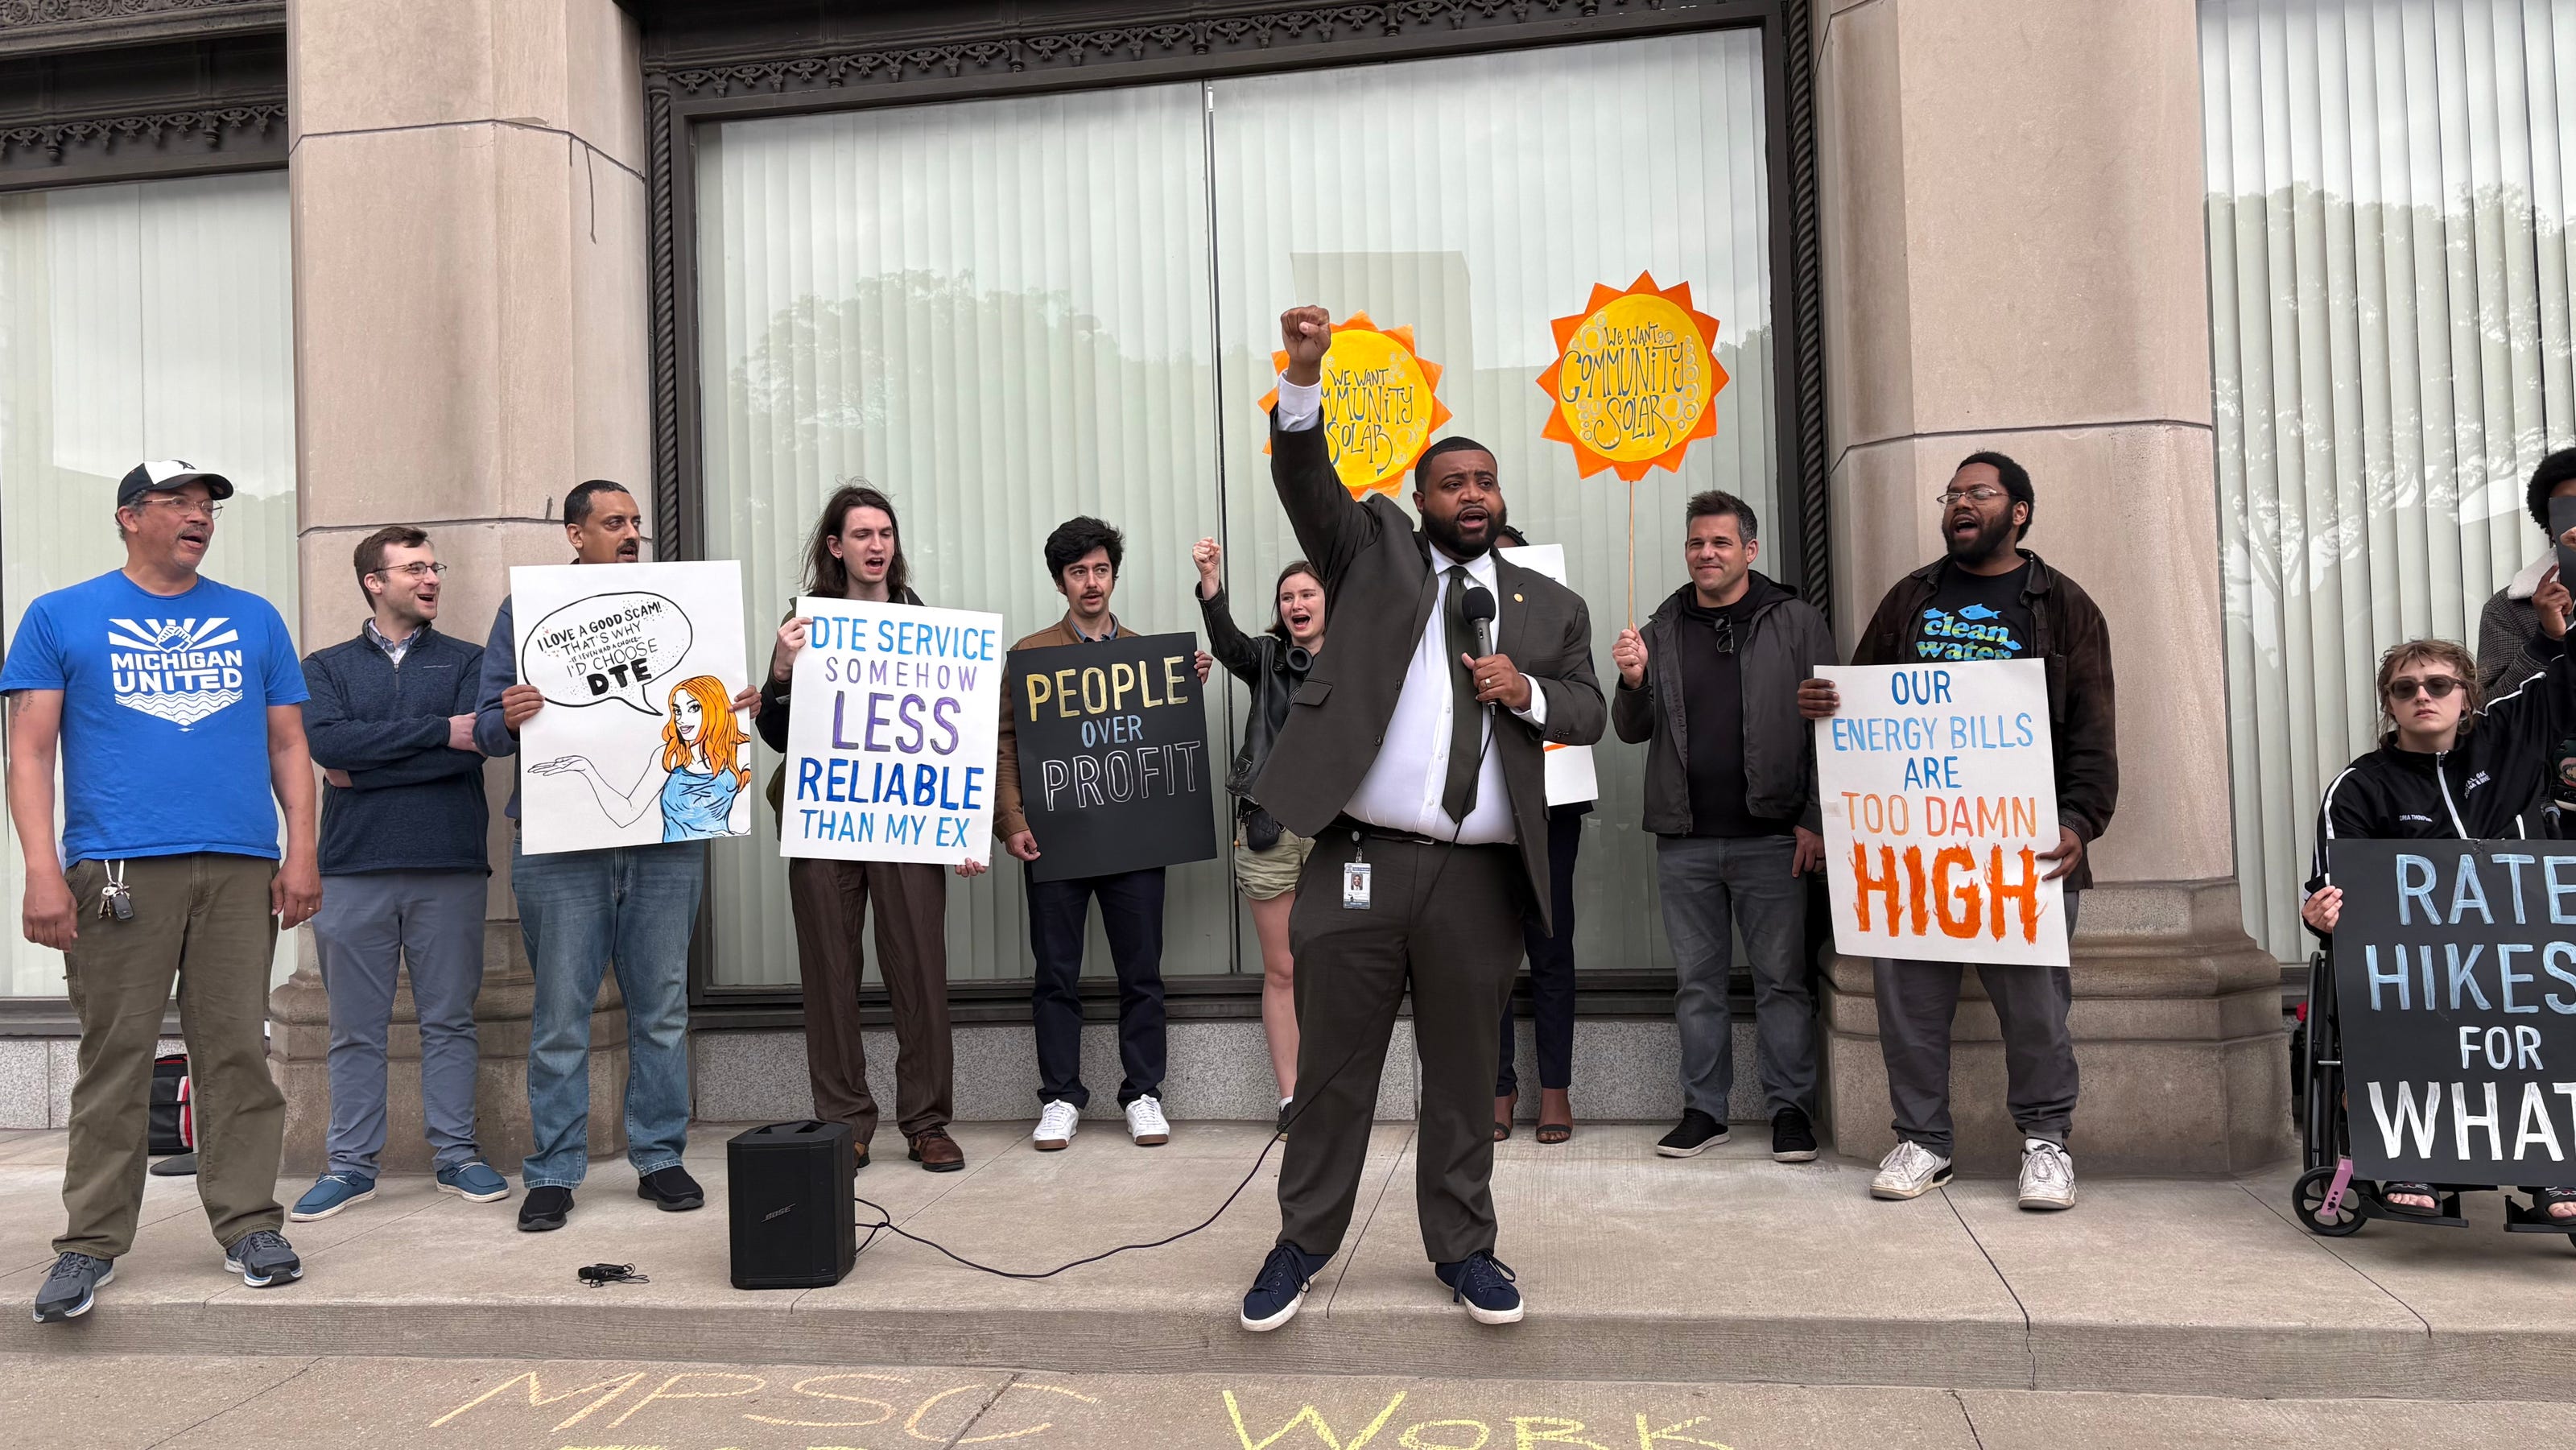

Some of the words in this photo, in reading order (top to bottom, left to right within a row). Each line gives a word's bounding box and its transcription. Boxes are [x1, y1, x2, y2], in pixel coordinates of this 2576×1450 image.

[1627, 321, 1658, 347] WANT
[1328, 369, 1351, 386] WE
[1354, 368, 1389, 386] WANT
[1593, 395, 1672, 450] SOLAR
[1327, 421, 1393, 477] SOLAR
[537, 639, 543, 651] I
[543, 628, 575, 648] LOVE
[579, 625, 588, 637] A
[589, 613, 622, 633] GOOD
[625, 601, 663, 622] SCAM!
[561, 632, 609, 655] THAT'S
[611, 621, 641, 639] WHY
[811, 616, 868, 651] DTE
[877, 620, 995, 661] SERVICE
[1924, 616, 2009, 642] clean
[110, 650, 242, 671] MICHIGAN
[567, 663, 587, 678] I'D
[592, 638, 658, 670] CHOOSE
[582, 650, 598, 659] EVEN
[598, 645, 611, 654] HAD
[1915, 641, 2013, 661] water
[113, 667, 242, 693] UNITED
[586, 658, 652, 696] DTE
[825, 656, 977, 692] SOMEHOW
[1026, 656, 1188, 722] PEOPLE
[1891, 670, 1952, 705] OUR
[832, 690, 961, 756] LESS
[1081, 715, 1143, 748] OVER
[1832, 717, 1938, 752] ENERGY
[1950, 713, 2033, 749] BILLS
[798, 757, 985, 811] RELIABLE
[1042, 741, 1201, 812] PROFIT
[1904, 756, 1963, 791] ARE
[799, 809, 874, 842] THAN
[886, 813, 927, 845] MY
[936, 816, 970, 847] EX
[1841, 791, 1909, 836] TOO
[1926, 795, 2037, 838] DAMN
[1848, 837, 2047, 946] HIGH
[2396, 853, 2576, 925] RATE
[2365, 941, 2576, 1014] HIKES
[2458, 1025, 2544, 1070] FOR
[763, 1204, 794, 1221] BOSE
[428, 1370, 1100, 1444] MPSC
